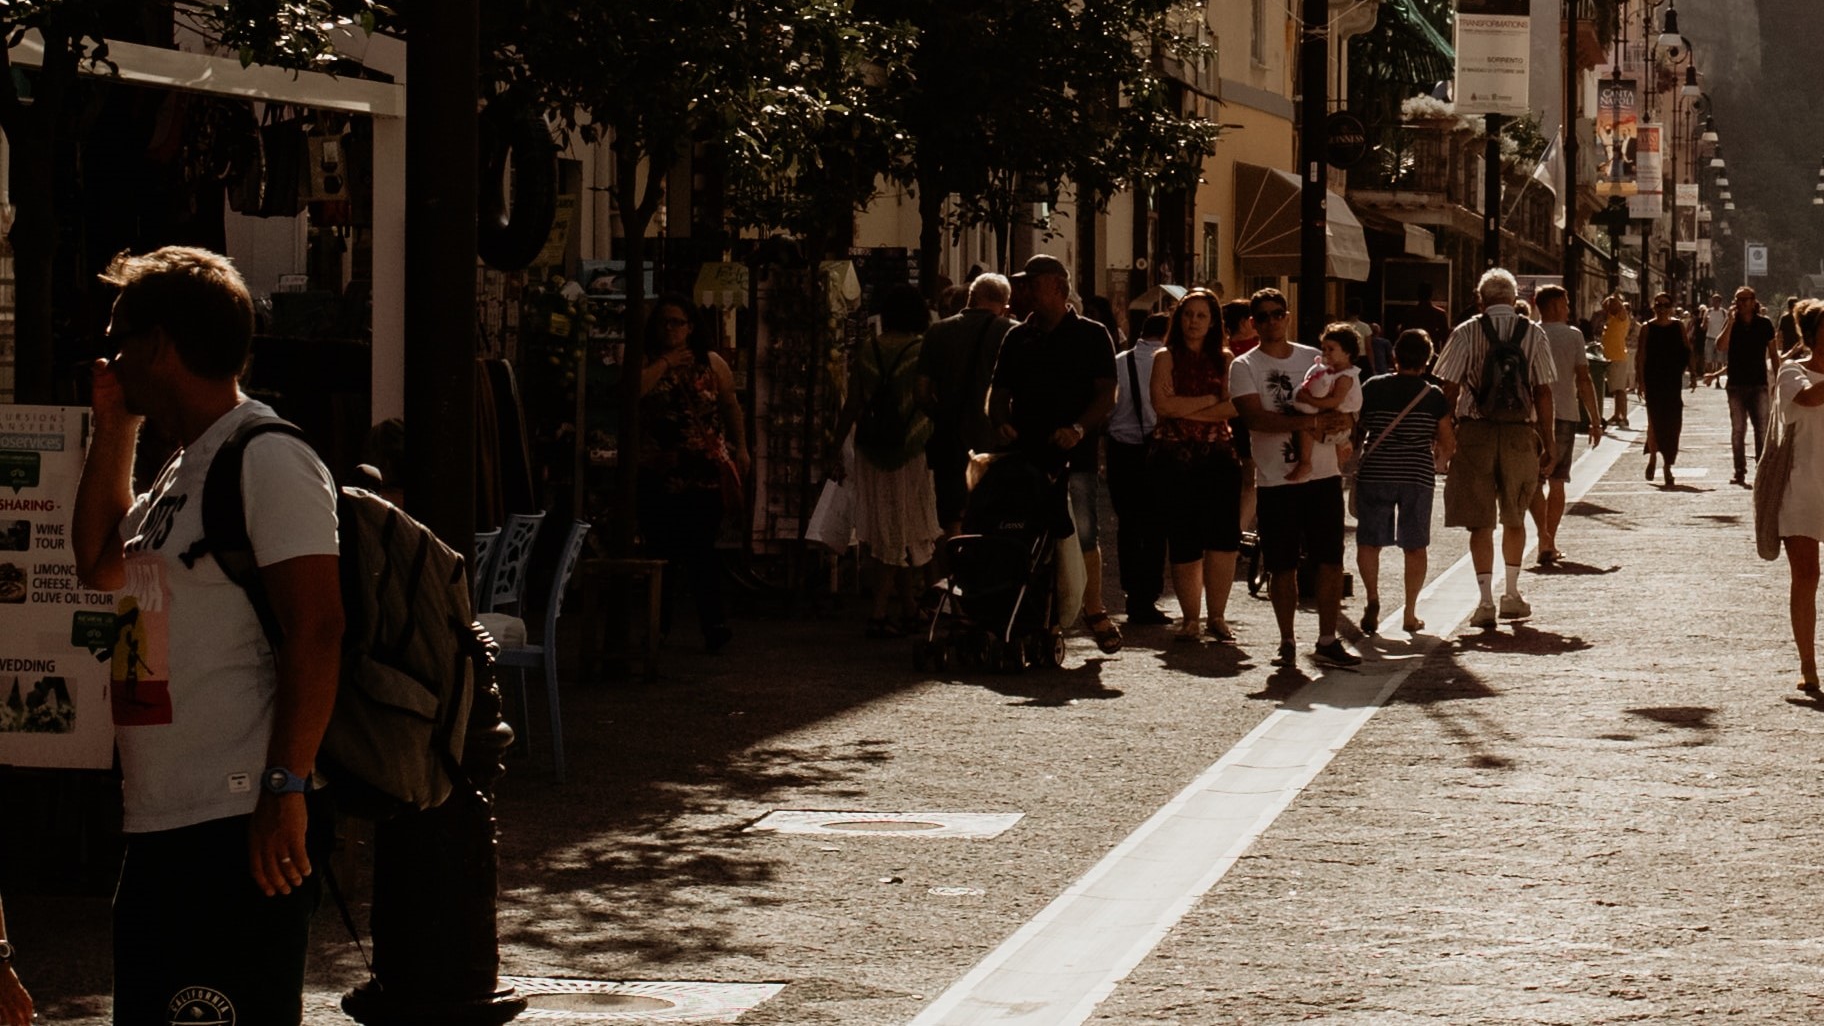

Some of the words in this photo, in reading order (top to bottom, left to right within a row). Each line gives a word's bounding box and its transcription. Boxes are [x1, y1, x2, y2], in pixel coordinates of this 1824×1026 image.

[1459, 19, 1528, 29] TRANSFORMATIONS
[1486, 56, 1524, 65] SORRENTO
[1601, 88, 1634, 99] CANTA
[1599, 96, 1634, 106] NAPOLI
[1327, 134, 1365, 144] UINNESS
[0, 499, 55, 512] SHARING
[36, 524, 65, 535] WINE
[36, 537, 66, 550] TOUR
[34, 564, 78, 576] LIMONC
[33, 578, 74, 591] CHEESE,
[32, 592, 62, 604] OLIVE
[65, 593, 82, 604] OIL
[85, 593, 114, 606] TOUR
[169, 988, 230, 1013] CALIFORNIA
